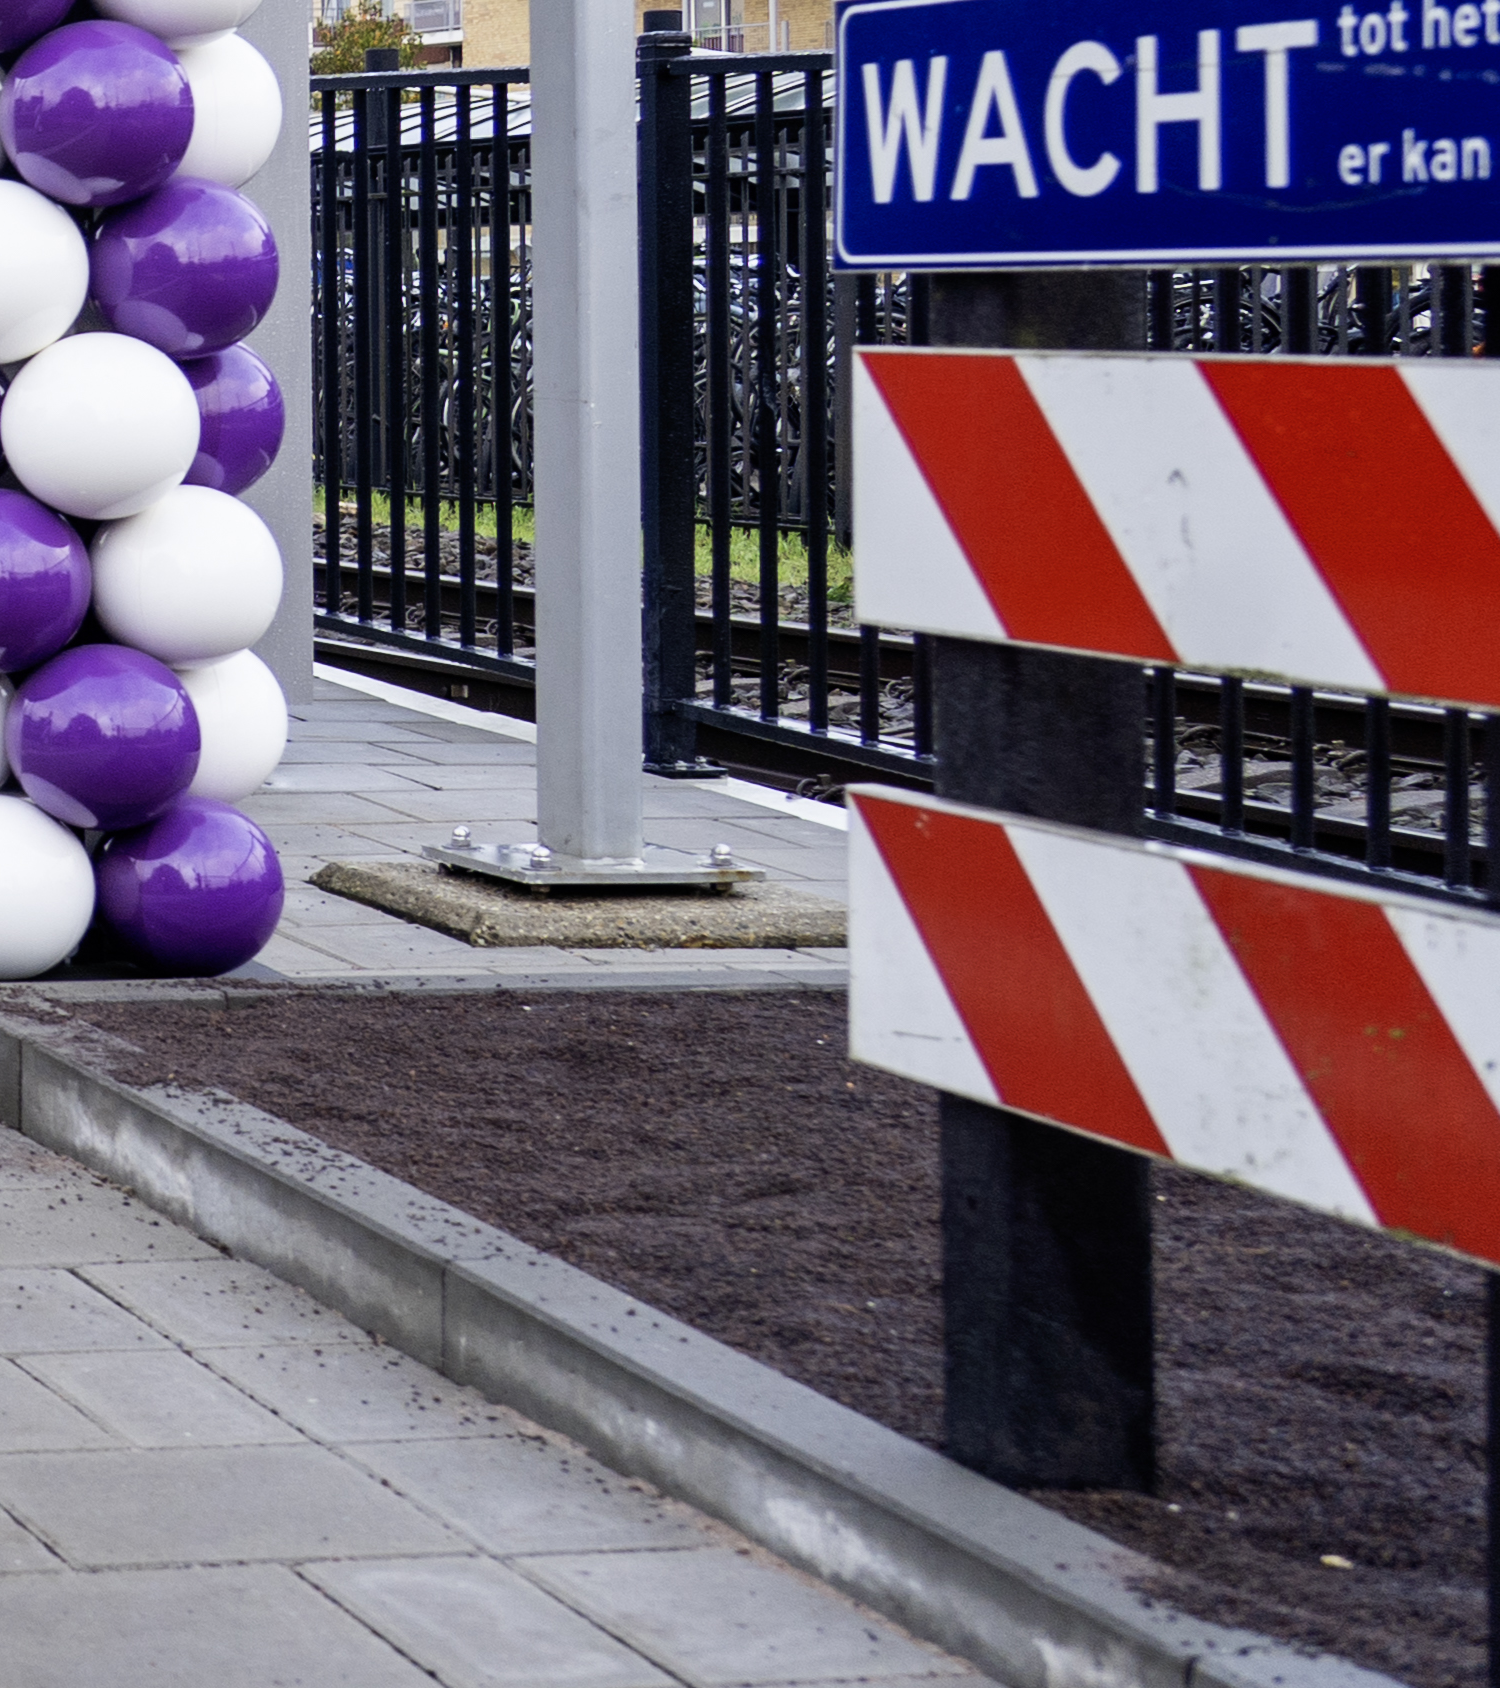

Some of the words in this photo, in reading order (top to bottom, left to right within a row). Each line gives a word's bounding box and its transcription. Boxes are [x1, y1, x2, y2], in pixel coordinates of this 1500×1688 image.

[862, 20, 1318, 204] WACHT
[1338, 0, 1408, 57] tot
[1338, 140, 1389, 186] er
[1401, 128, 1490, 183] kan
